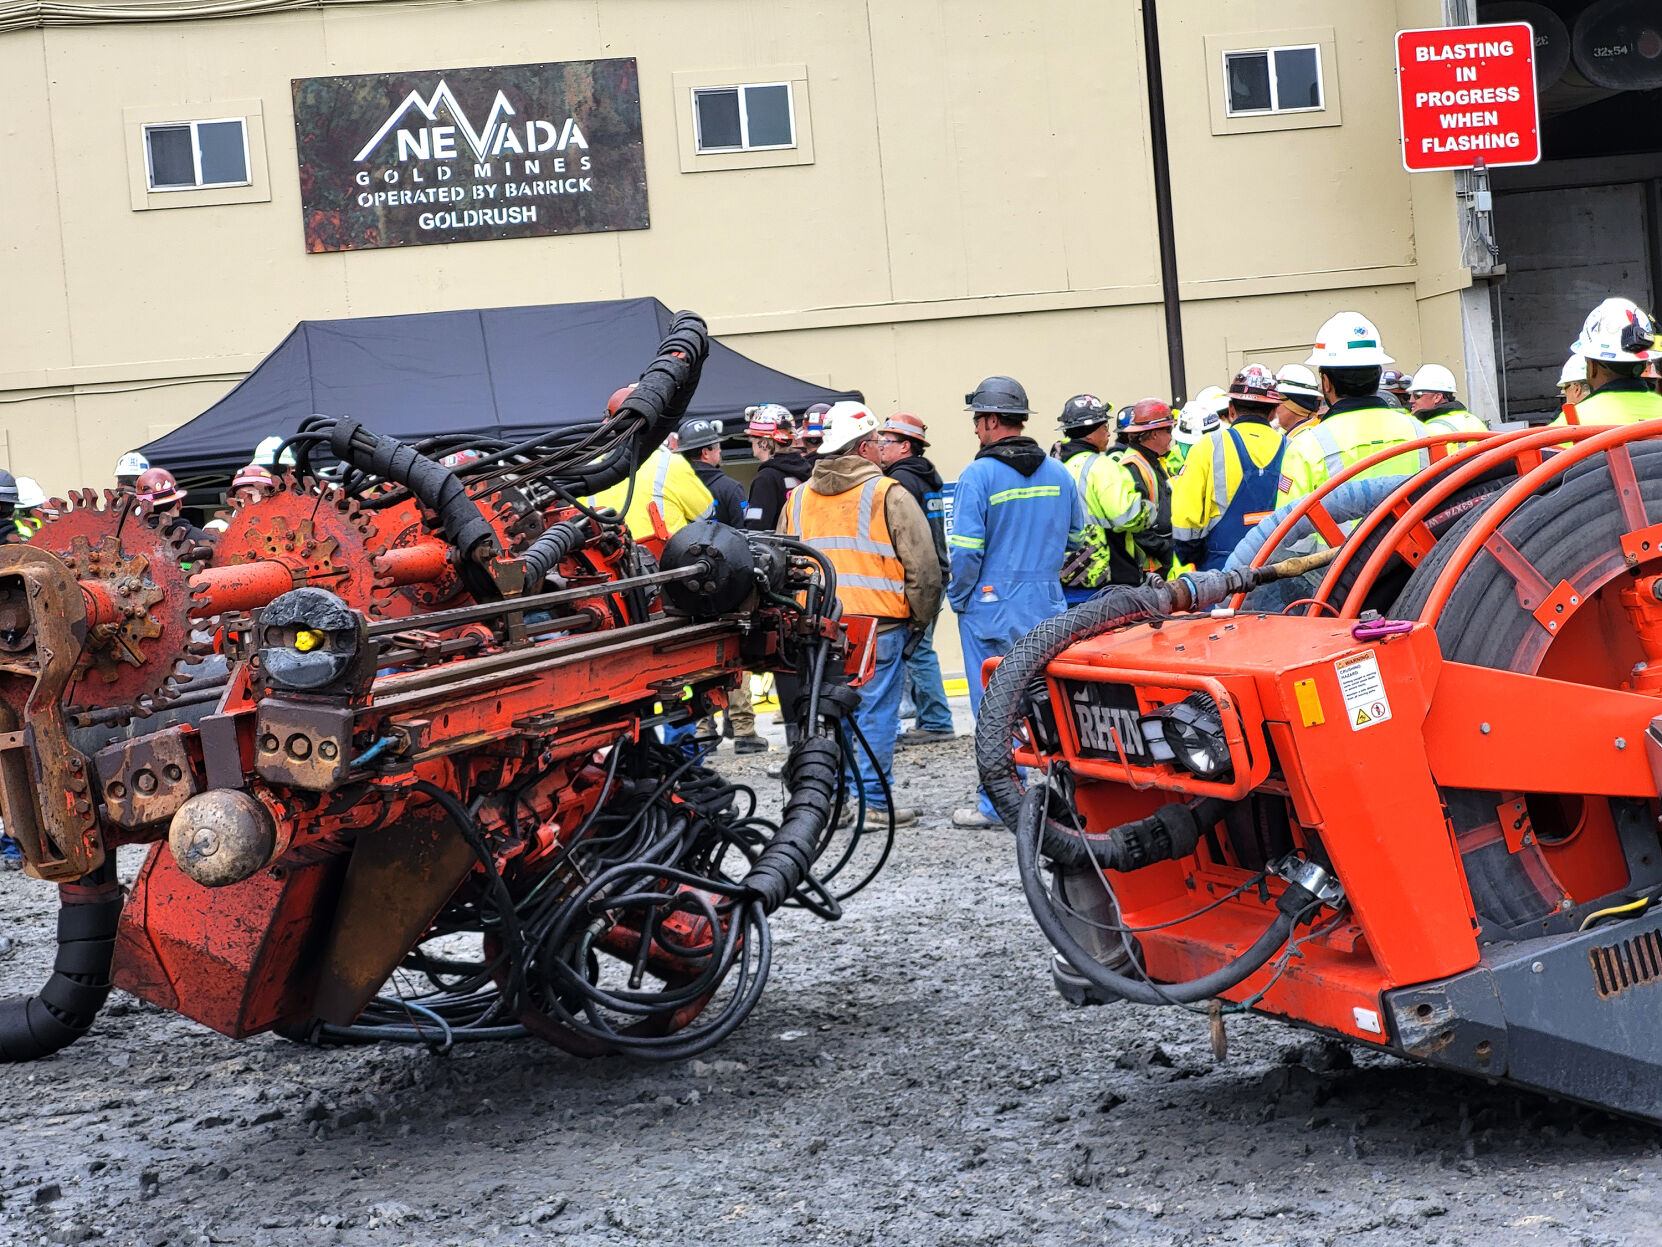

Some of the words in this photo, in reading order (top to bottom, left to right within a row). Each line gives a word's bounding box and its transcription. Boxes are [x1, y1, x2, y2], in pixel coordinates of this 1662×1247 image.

[1415, 41, 1514, 62] BLASTING
[1455, 66, 1477, 82] IN
[1415, 86, 1520, 108] PROGRESS
[1439, 111, 1498, 129] WHEN
[396, 117, 590, 163] NEVADA
[1421, 132, 1520, 153] FLASHING
[355, 165, 452, 186] GOLD
[474, 156, 592, 179] MINES
[357, 186, 465, 208] OPERATED
[472, 183, 497, 200] BY
[505, 177, 593, 198] BARRICK
[418, 205, 538, 230] GOLDRUSH
[1074, 703, 1146, 757] RHIN
